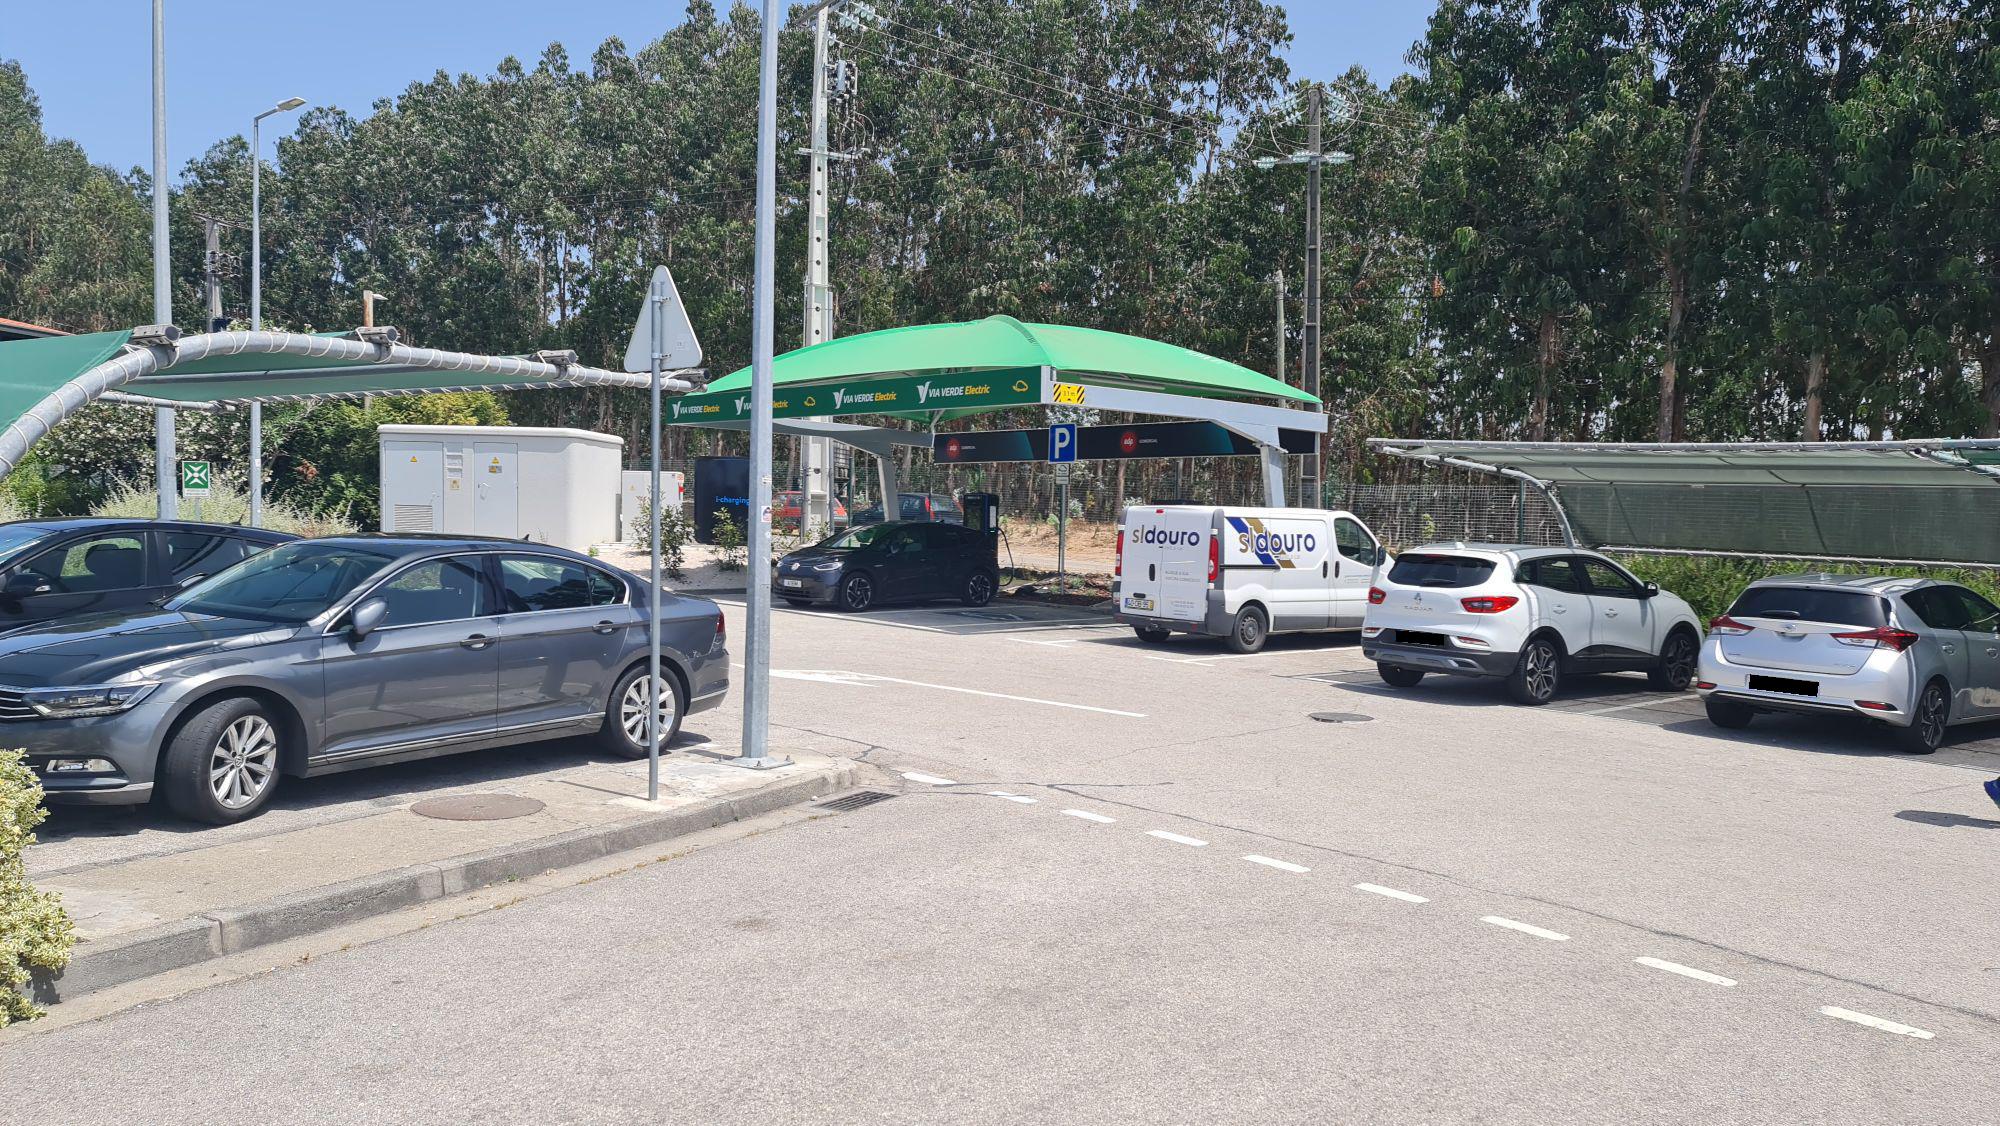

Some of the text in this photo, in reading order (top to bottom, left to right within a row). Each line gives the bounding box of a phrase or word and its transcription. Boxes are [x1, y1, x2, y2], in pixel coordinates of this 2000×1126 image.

[843, 391, 897, 404] VIA VERDE Electric
[928, 384, 991, 398] VIA VERDE Electric
[680, 406, 688, 414] VIA
[688, 405, 703, 414] VERDE
[1054, 427, 1070, 459] P
